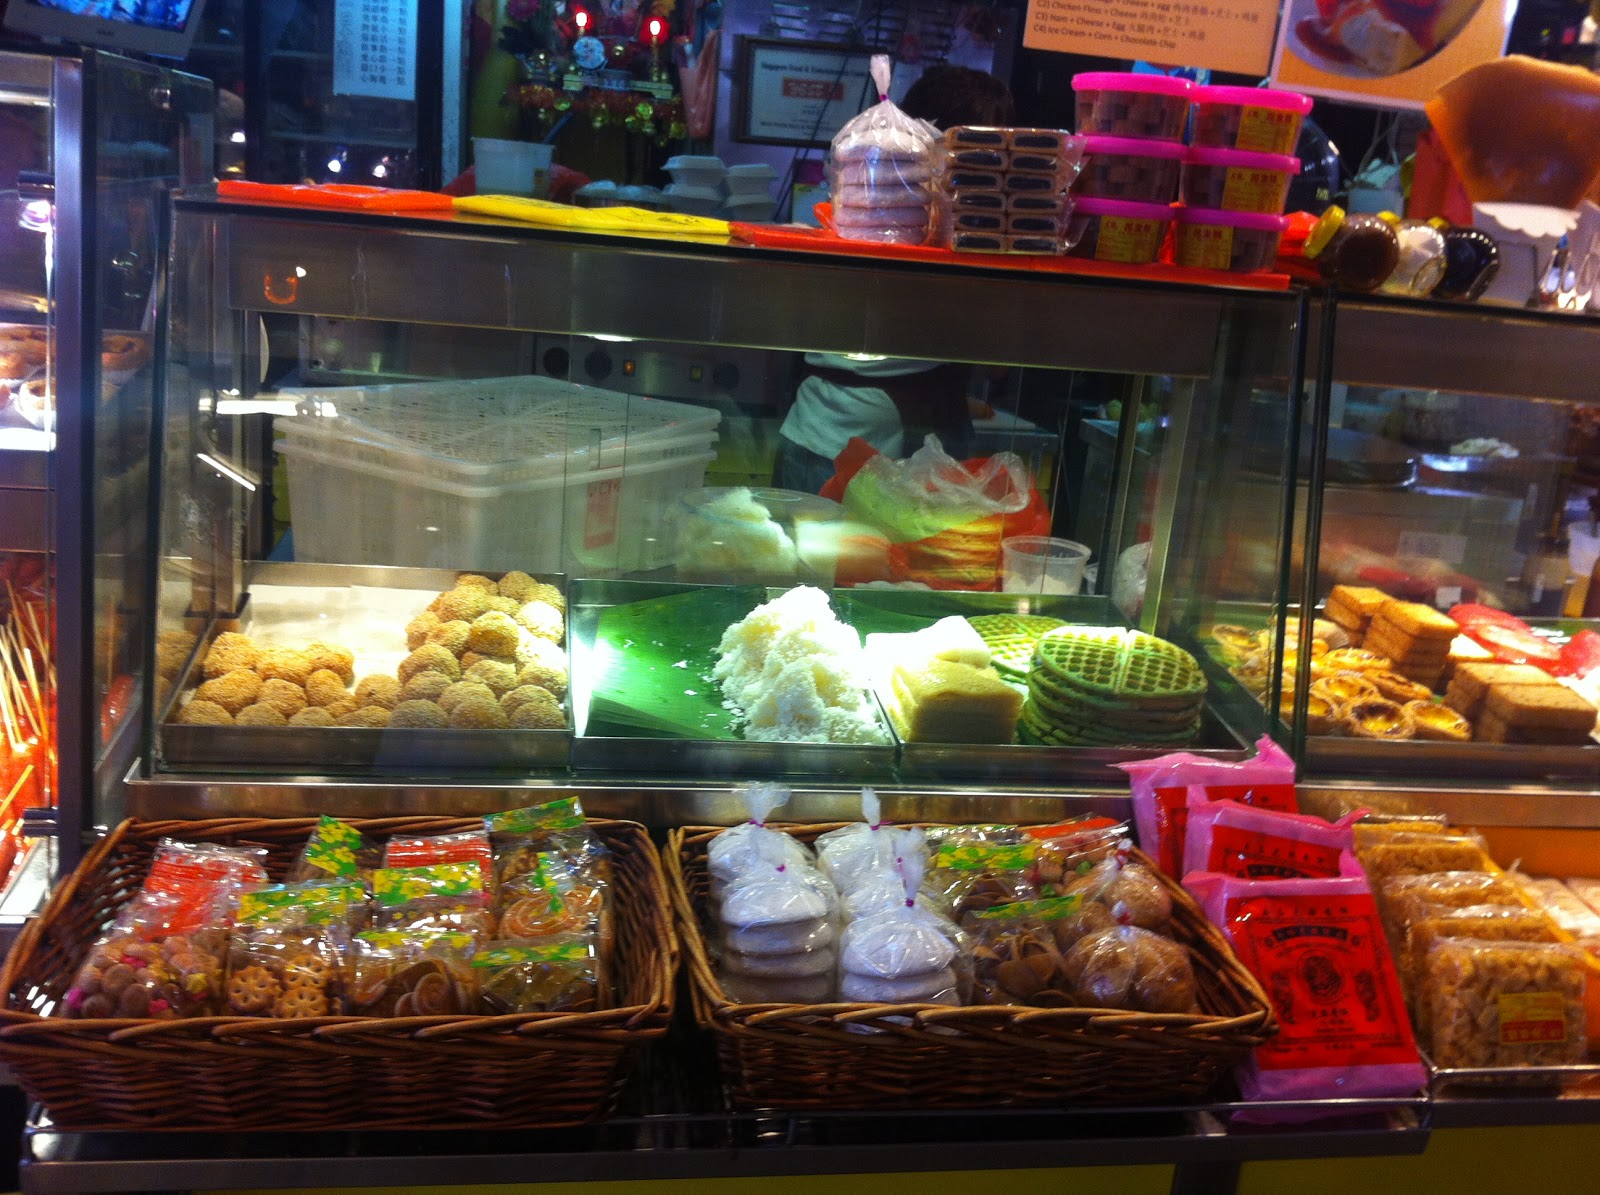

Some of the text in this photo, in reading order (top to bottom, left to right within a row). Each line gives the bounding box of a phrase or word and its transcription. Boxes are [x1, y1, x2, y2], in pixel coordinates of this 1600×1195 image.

[1076, 17, 1104, 27] Cheese
[1061, 27, 1086, 37] Cream
[1094, 31, 1113, 40] Corn
